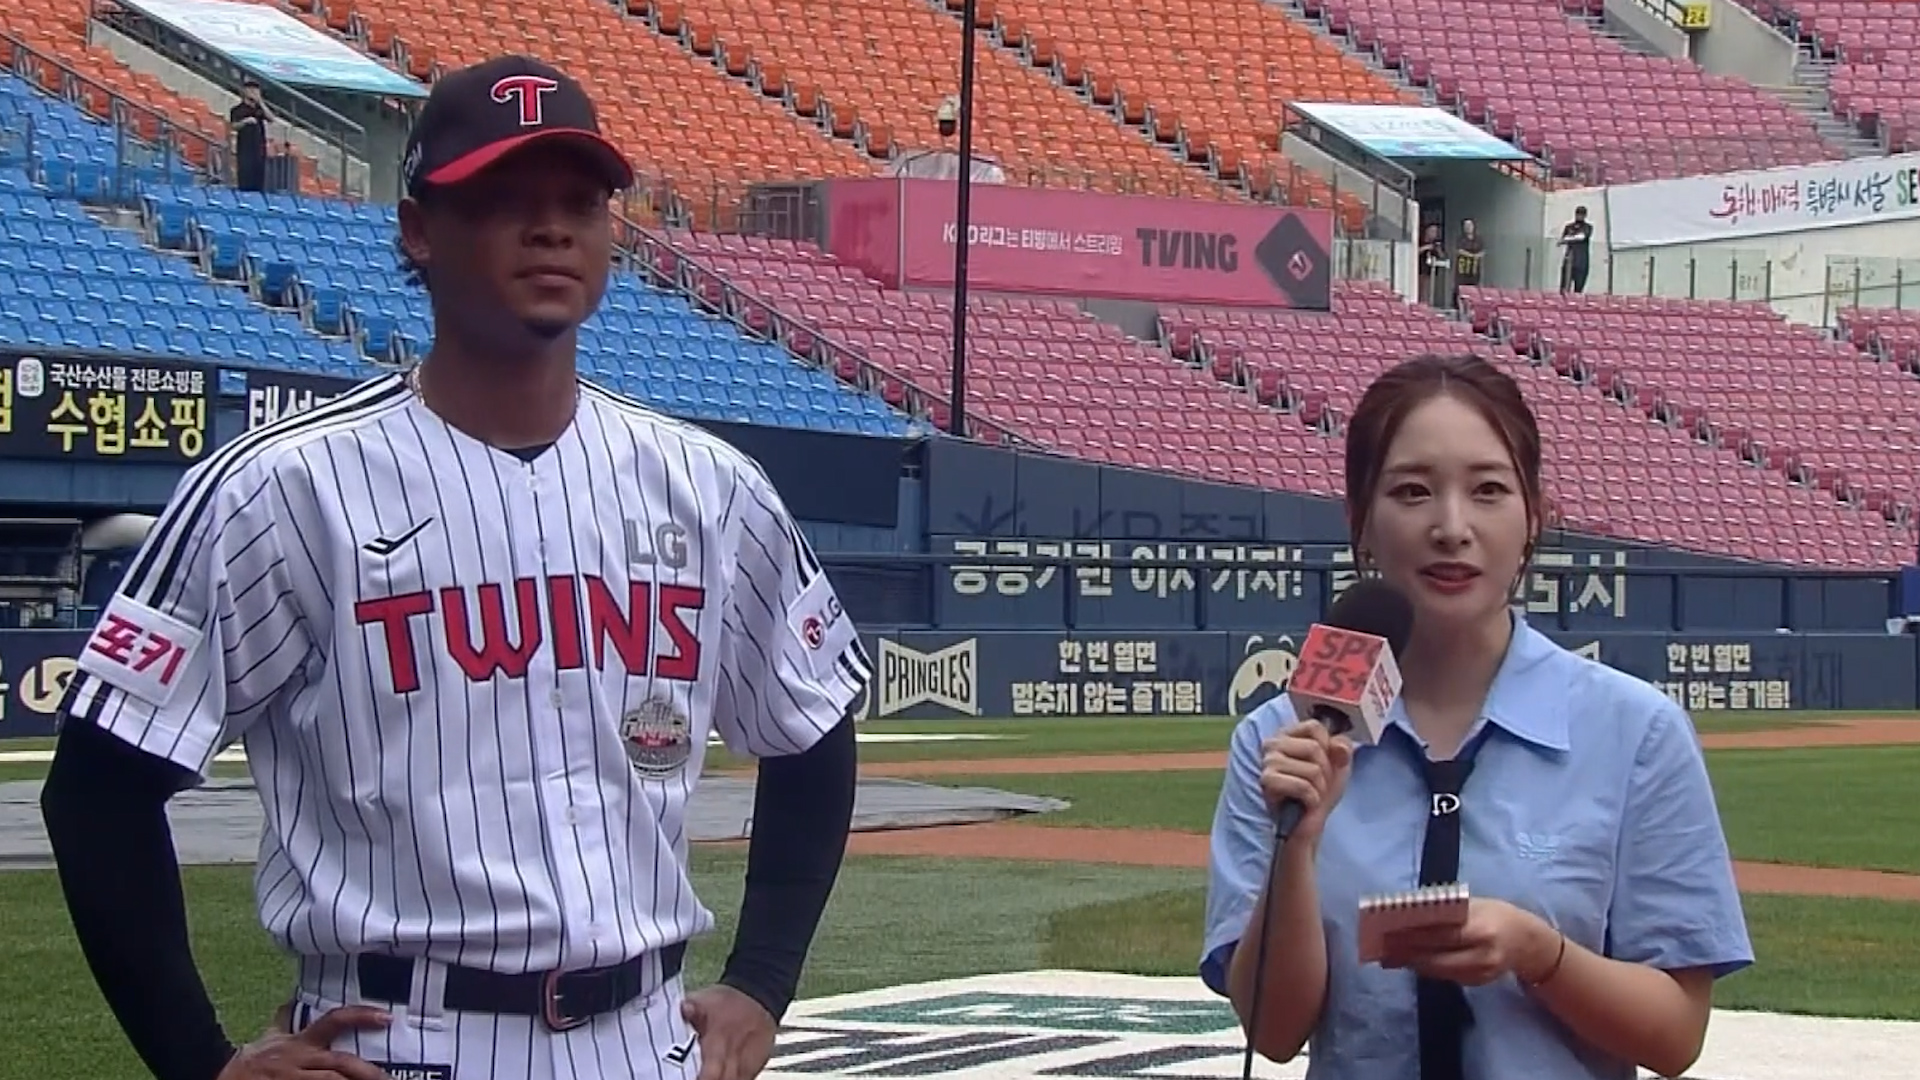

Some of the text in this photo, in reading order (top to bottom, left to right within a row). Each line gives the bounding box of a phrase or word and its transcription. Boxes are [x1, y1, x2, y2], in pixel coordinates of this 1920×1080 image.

[490, 75, 558, 126] T
[1854, 172, 1893, 212] 서울
[1896, 168, 1920, 206] SE
[943, 223, 1018, 248] KO리그는
[1073, 232, 1122, 255] 스트리밍
[1136, 227, 1238, 273] TVING
[50, 363, 128, 391] 국산수산물
[130, 368, 205, 394] 전문쇼핑몰
[47, 391, 206, 457] 수협쇼핑
[626, 519, 687, 569] LG
[950, 541, 1112, 596] 공공기관
[1131, 545, 1302, 600] 이사가자!
[354, 573, 705, 694] TWINS
[819, 595, 843, 630] LG
[89, 613, 186, 686] 포키
[1059, 640, 1157, 673] 한 번 열면
[1667, 642, 1751, 673] 한 번 열면
[885, 651, 971, 704] PRINGLES
[1012, 681, 1202, 715] 멈추지 않는 즐거움!
[1688, 680, 1726, 709] 않는
[1729, 680, 1790, 709] 즐거움!
